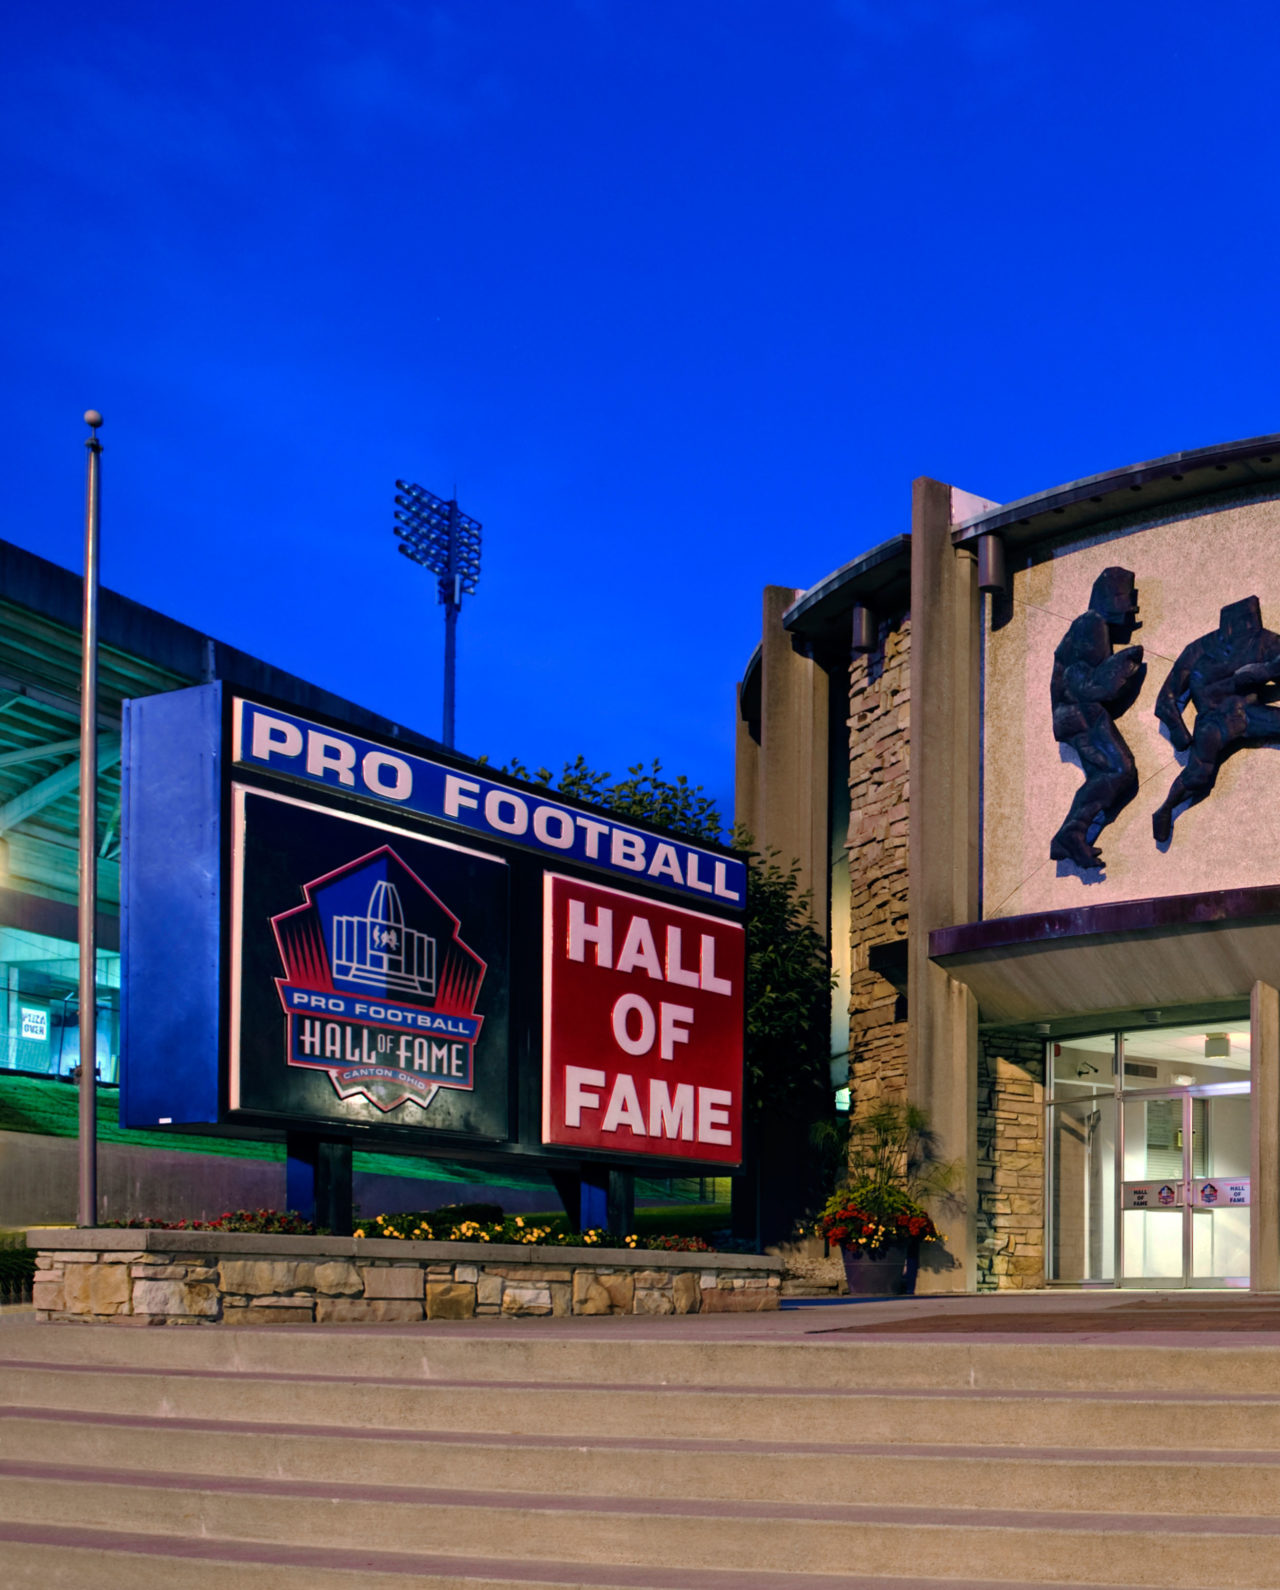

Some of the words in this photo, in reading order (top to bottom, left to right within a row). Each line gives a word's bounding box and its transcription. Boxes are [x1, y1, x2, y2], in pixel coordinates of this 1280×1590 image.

[252, 710, 413, 800] PRO
[443, 779, 741, 901] FOOTBALL
[566, 898, 732, 996] HALL
[293, 992, 345, 1012] PRO
[355, 1003, 470, 1034] FOOTBALL
[611, 993, 695, 1061] OF
[300, 1019, 376, 1064] HALL
[377, 1033, 395, 1053] OF
[396, 1035, 464, 1077] FAME
[343, 1068, 393, 1080] CANTON
[398, 1073, 427, 1091] OHIO
[564, 1064, 733, 1146] FAME
